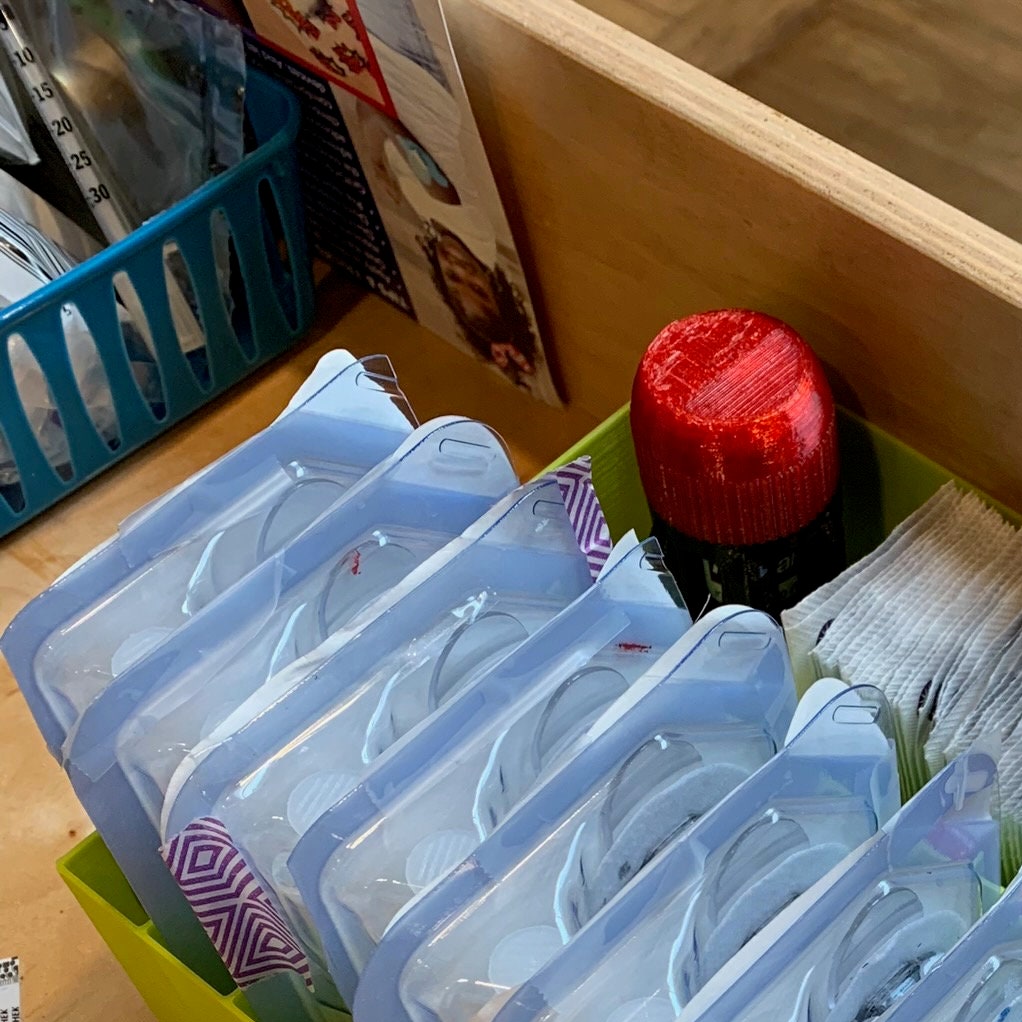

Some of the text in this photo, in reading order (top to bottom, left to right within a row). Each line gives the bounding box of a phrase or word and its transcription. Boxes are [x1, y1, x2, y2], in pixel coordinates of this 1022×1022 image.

[14, 47, 35, 67] 10
[33, 82, 54, 101] 15
[52, 116, 73, 136] 20
[71, 151, 92, 170] 25
[89, 184, 111, 203] 30
